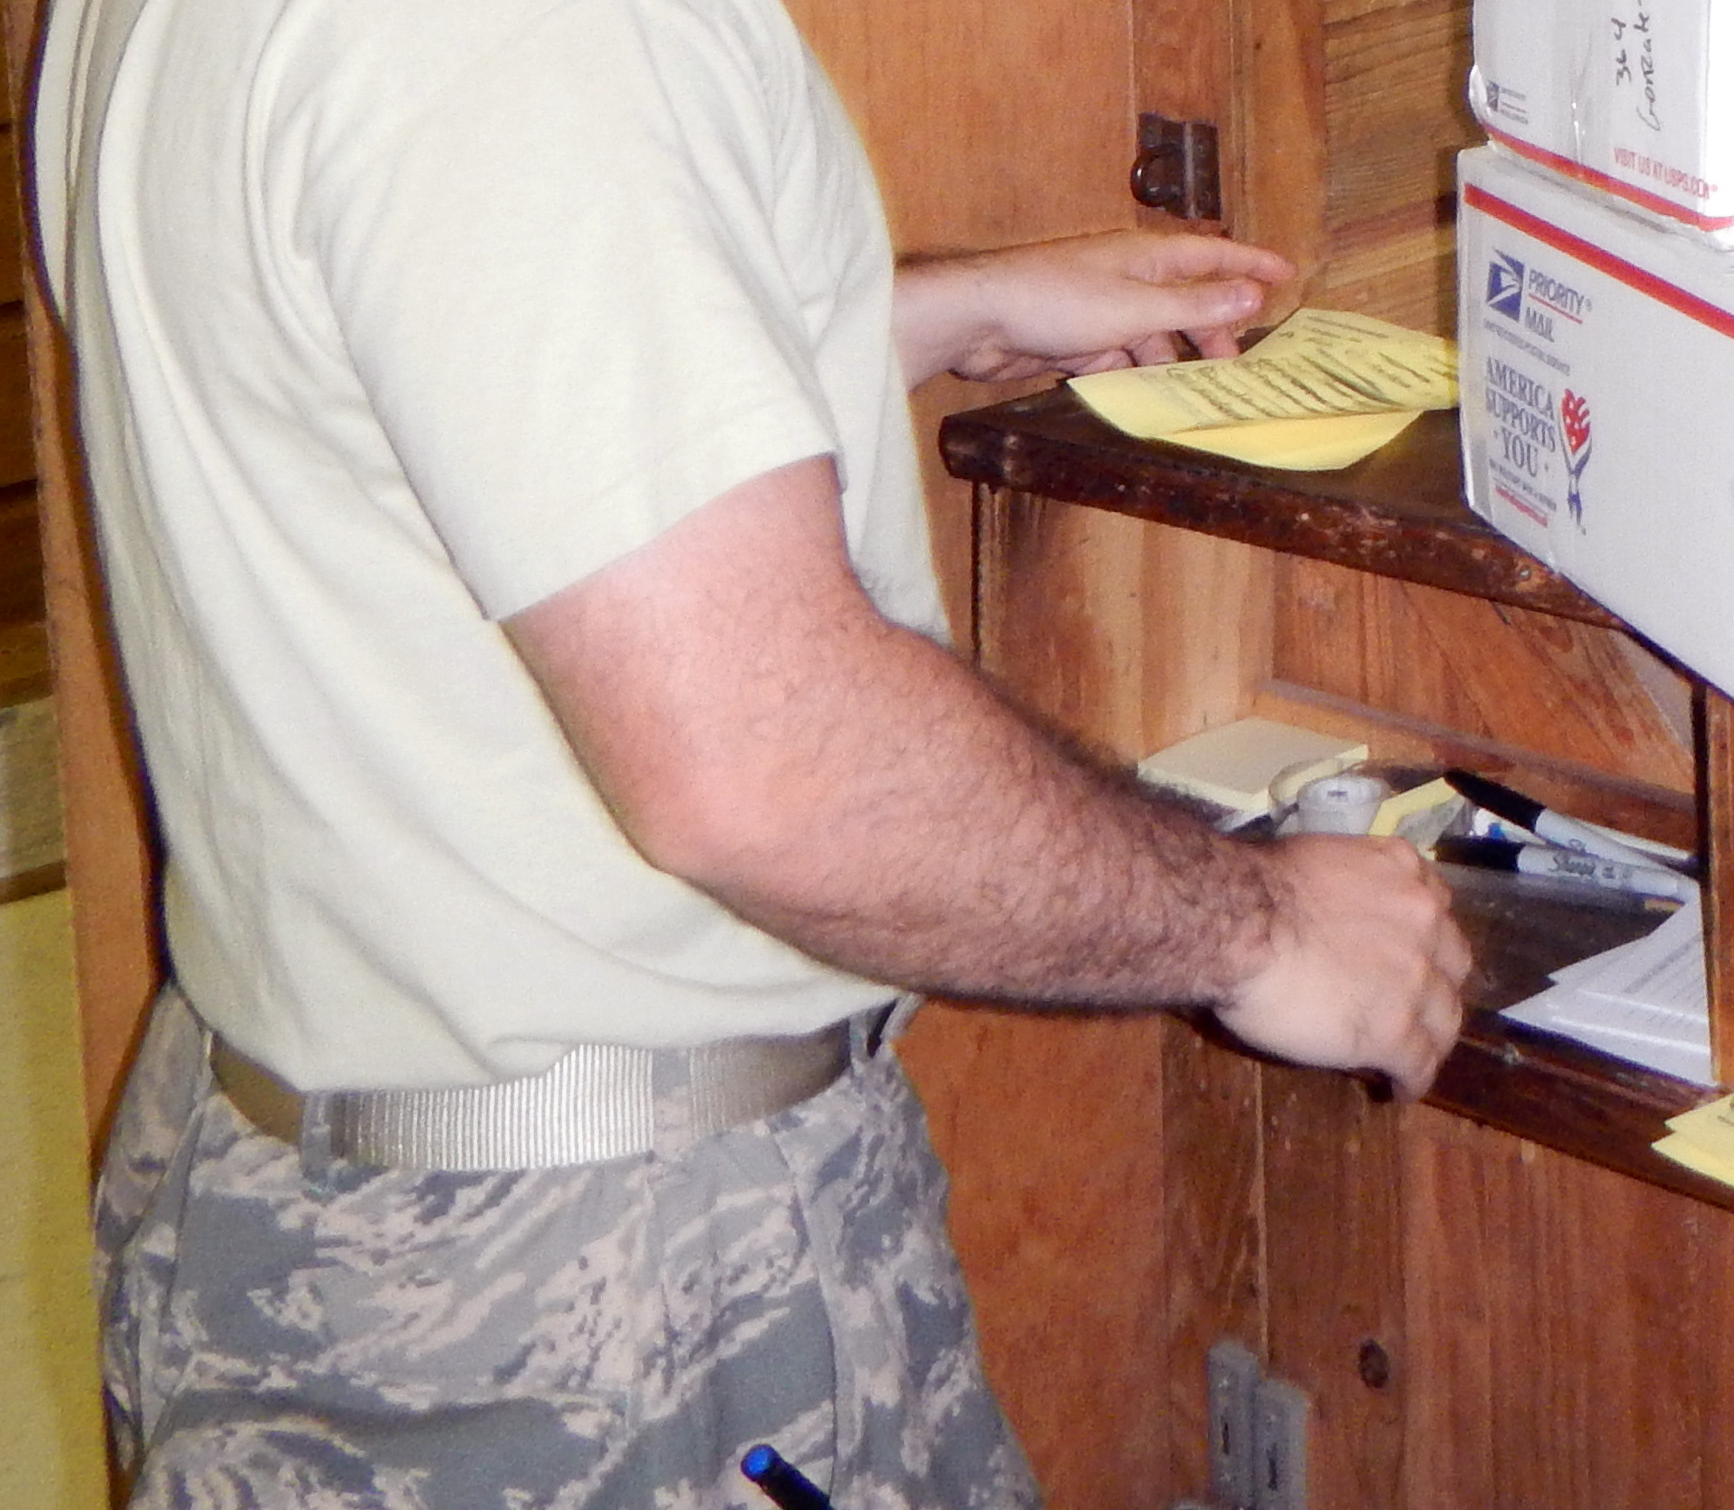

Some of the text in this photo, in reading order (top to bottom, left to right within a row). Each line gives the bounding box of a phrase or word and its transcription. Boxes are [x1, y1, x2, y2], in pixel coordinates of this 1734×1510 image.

[1527, 268, 1586, 316] PRIORITY
[1523, 306, 1555, 343] MAIL
[1485, 355, 1556, 421] AMERICA
[1485, 386, 1557, 453] SUPPORTS
[1500, 428, 1538, 478] YOU
